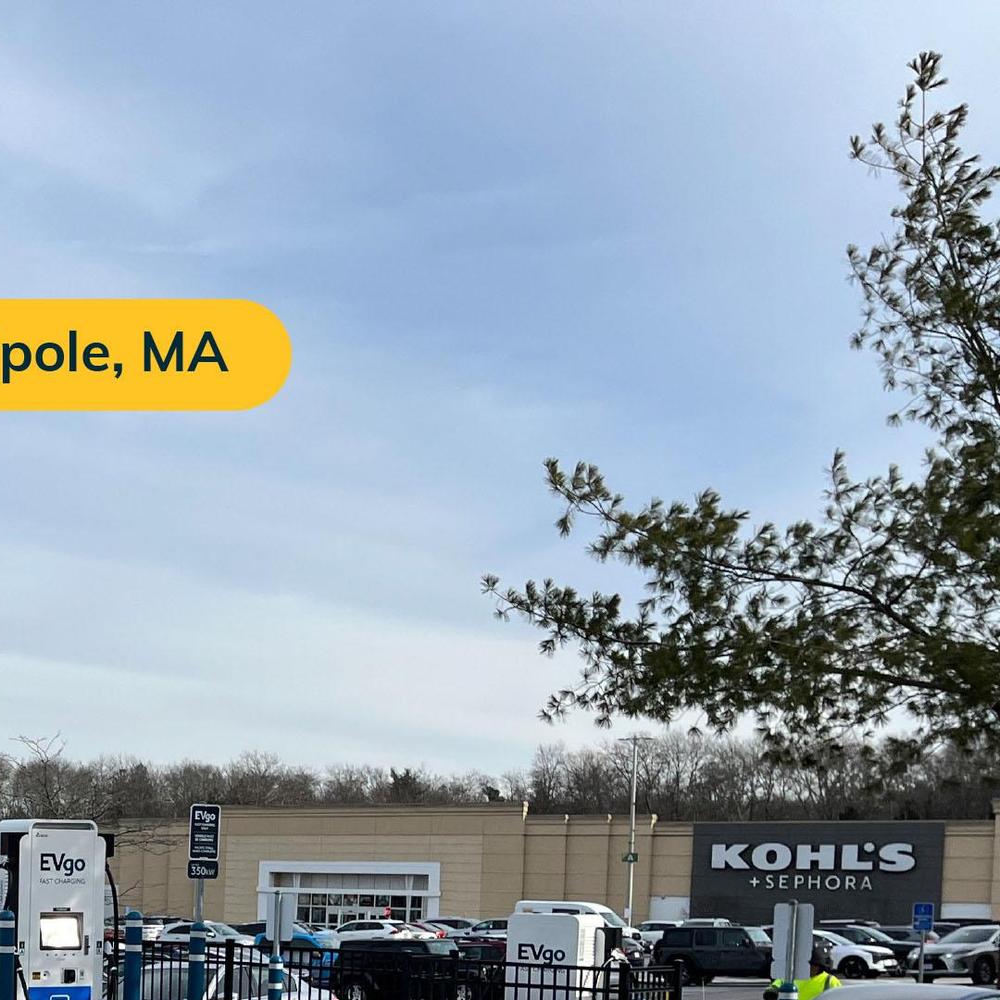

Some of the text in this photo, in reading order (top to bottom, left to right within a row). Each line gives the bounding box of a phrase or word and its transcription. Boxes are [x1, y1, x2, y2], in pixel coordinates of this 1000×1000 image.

[194, 810, 216, 823] EVgo
[40, 853, 86, 877] EVgo
[711, 842, 916, 873] KOHL'S
[517, 943, 566, 966] EVgo
